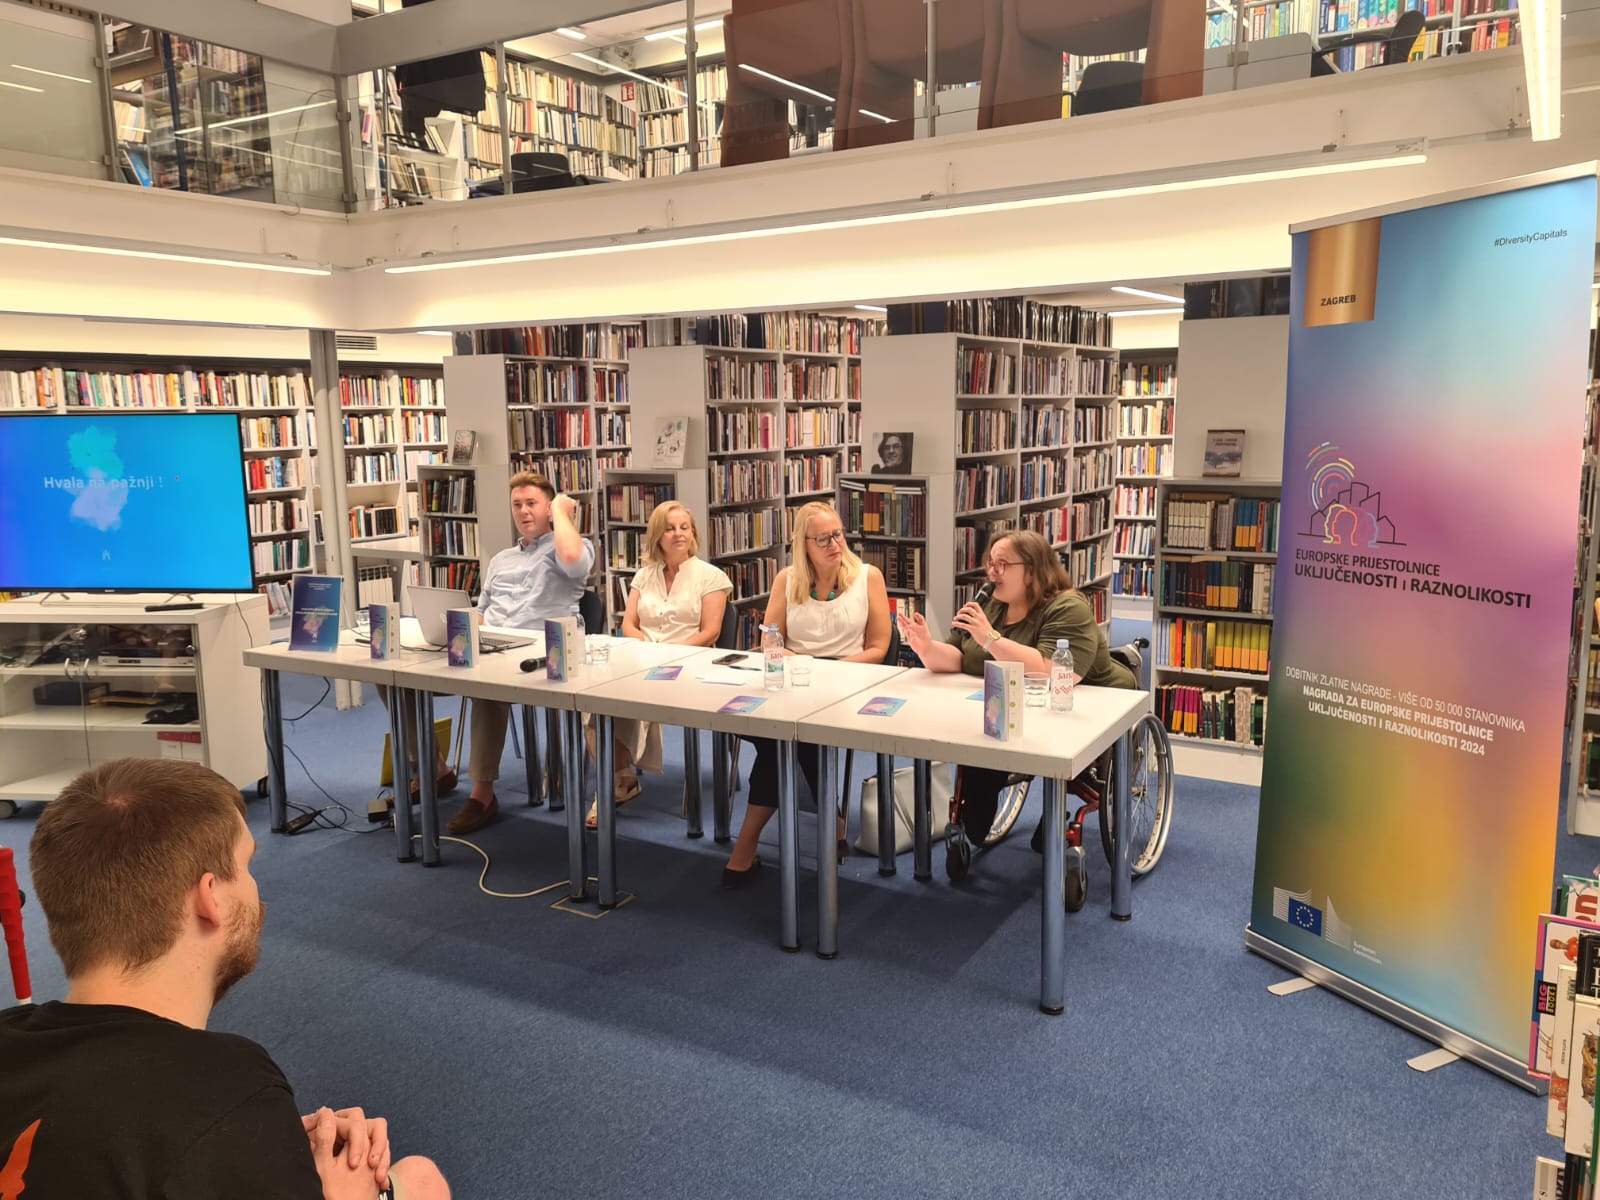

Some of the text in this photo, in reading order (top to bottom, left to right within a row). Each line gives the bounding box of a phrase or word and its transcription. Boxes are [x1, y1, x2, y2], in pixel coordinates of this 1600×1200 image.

[1320, 294, 1356, 306] ZAGREB
[44, 476, 164, 490] Hvala na pažnji !
[1296, 548, 1440, 576] EUROPSKE PRIJESTOLNICE
[1294, 563, 1398, 589] UKLJUČENOSTI
[1410, 578, 1531, 608] RAZNOLIKOSTI
[1286, 666, 1319, 684] DOBITNIK
[1320, 674, 1349, 690] ZLATNE
[1350, 682, 1391, 700] NAGRADE
[1398, 691, 1418, 706] VIŠE
[1420, 697, 1433, 710] OD
[1435, 700, 1446, 712] 50
[1447, 703, 1463, 717] 000
[1464, 706, 1526, 733] STANOVNIKA
[1303, 685, 1494, 741] NAGRADA ZA EUROPSKE PRIJESTOLNICE
[1379, 718, 1383, 729] I
[1385, 720, 1458, 748] RAZNOLIKOSTI
[1460, 739, 1485, 756] 2024
[1538, 984, 1548, 1011] BIG
